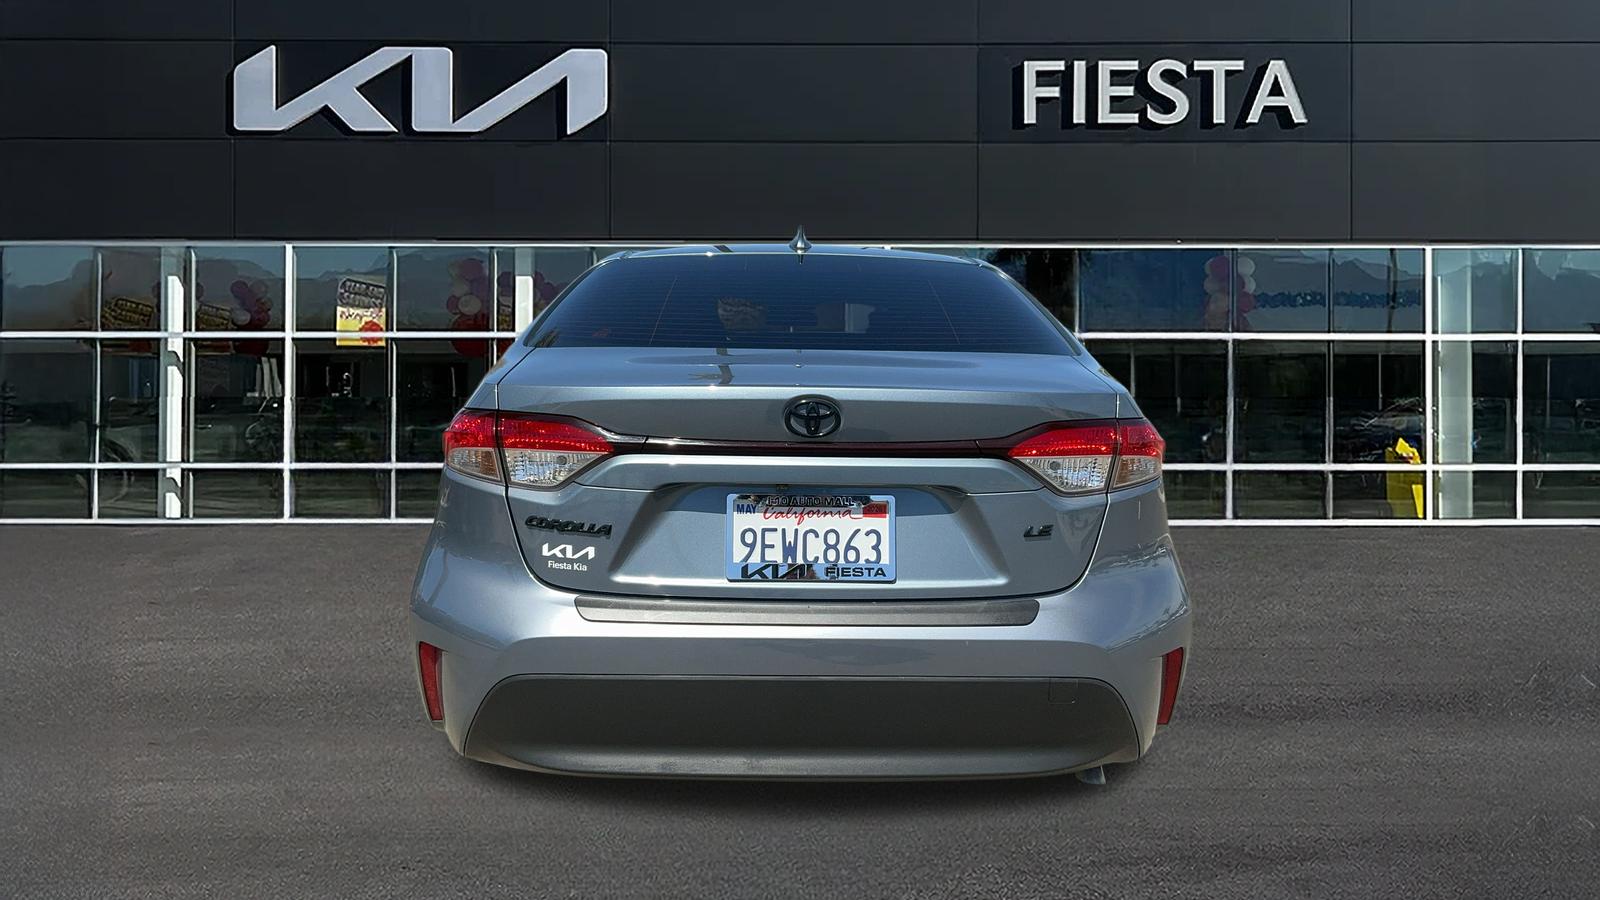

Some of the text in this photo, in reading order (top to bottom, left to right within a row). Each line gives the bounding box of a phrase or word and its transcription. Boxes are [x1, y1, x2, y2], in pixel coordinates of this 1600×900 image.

[233, 45, 609, 134] KIA
[1023, 59, 1308, 125] FIESTA
[790, 495, 822, 506] AUTO
[825, 495, 855, 506] MALL
[736, 504, 757, 514] MAY
[763, 506, 863, 525] California
[1023, 524, 1054, 538] LE
[740, 527, 881, 563] 9EWC863
[548, 560, 588, 571] Fiesta Kia
[825, 567, 887, 578] FIESTA
